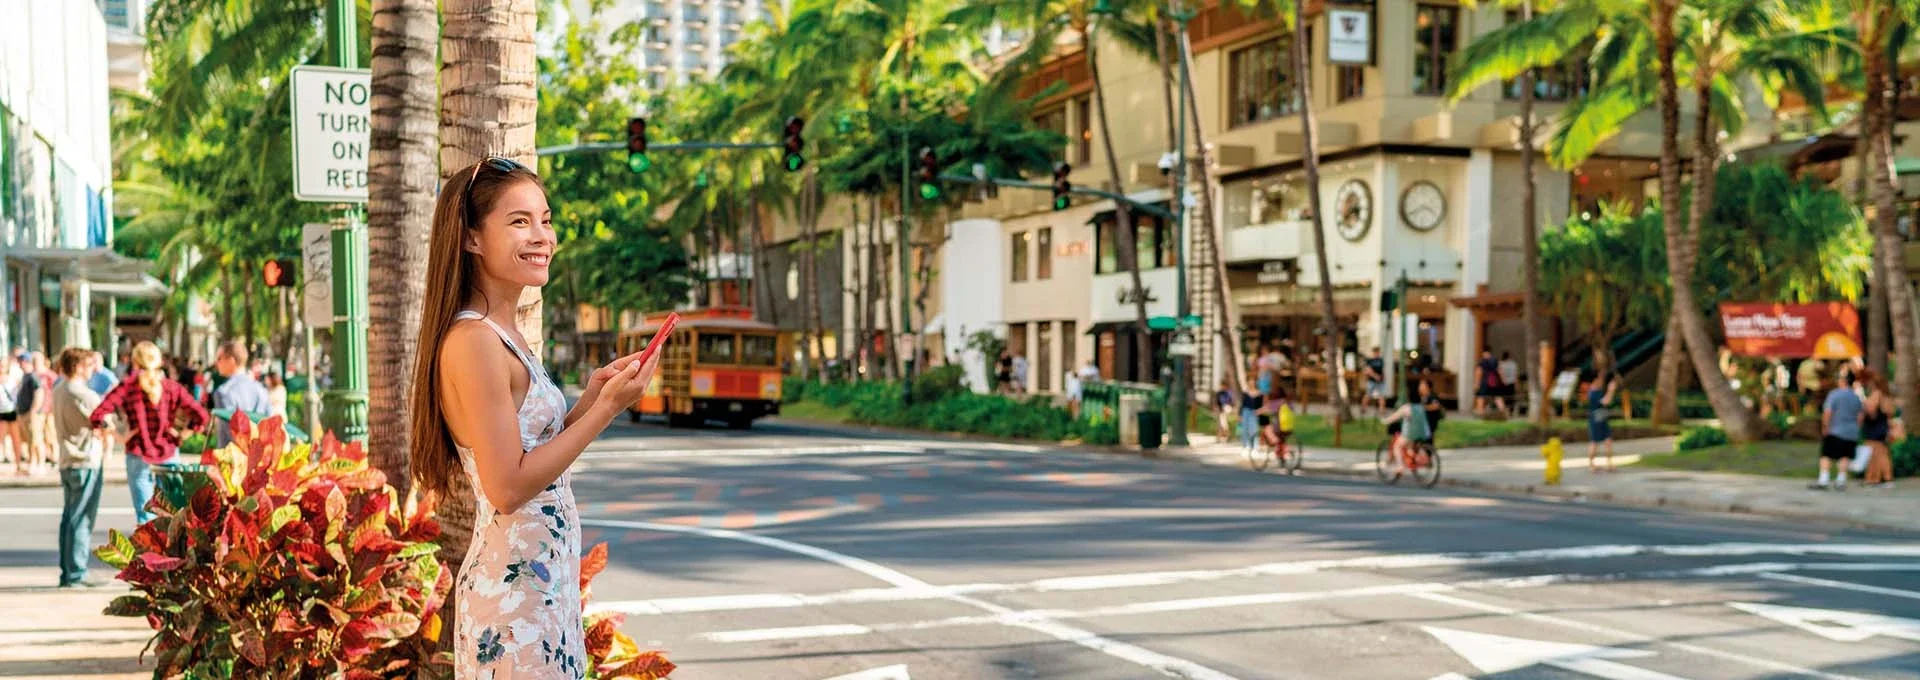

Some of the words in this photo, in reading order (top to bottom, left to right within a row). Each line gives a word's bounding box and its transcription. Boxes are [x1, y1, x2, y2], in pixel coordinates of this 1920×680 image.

[325, 82, 367, 105] NO
[333, 141, 362, 160] ON
[327, 169, 369, 188] RED
